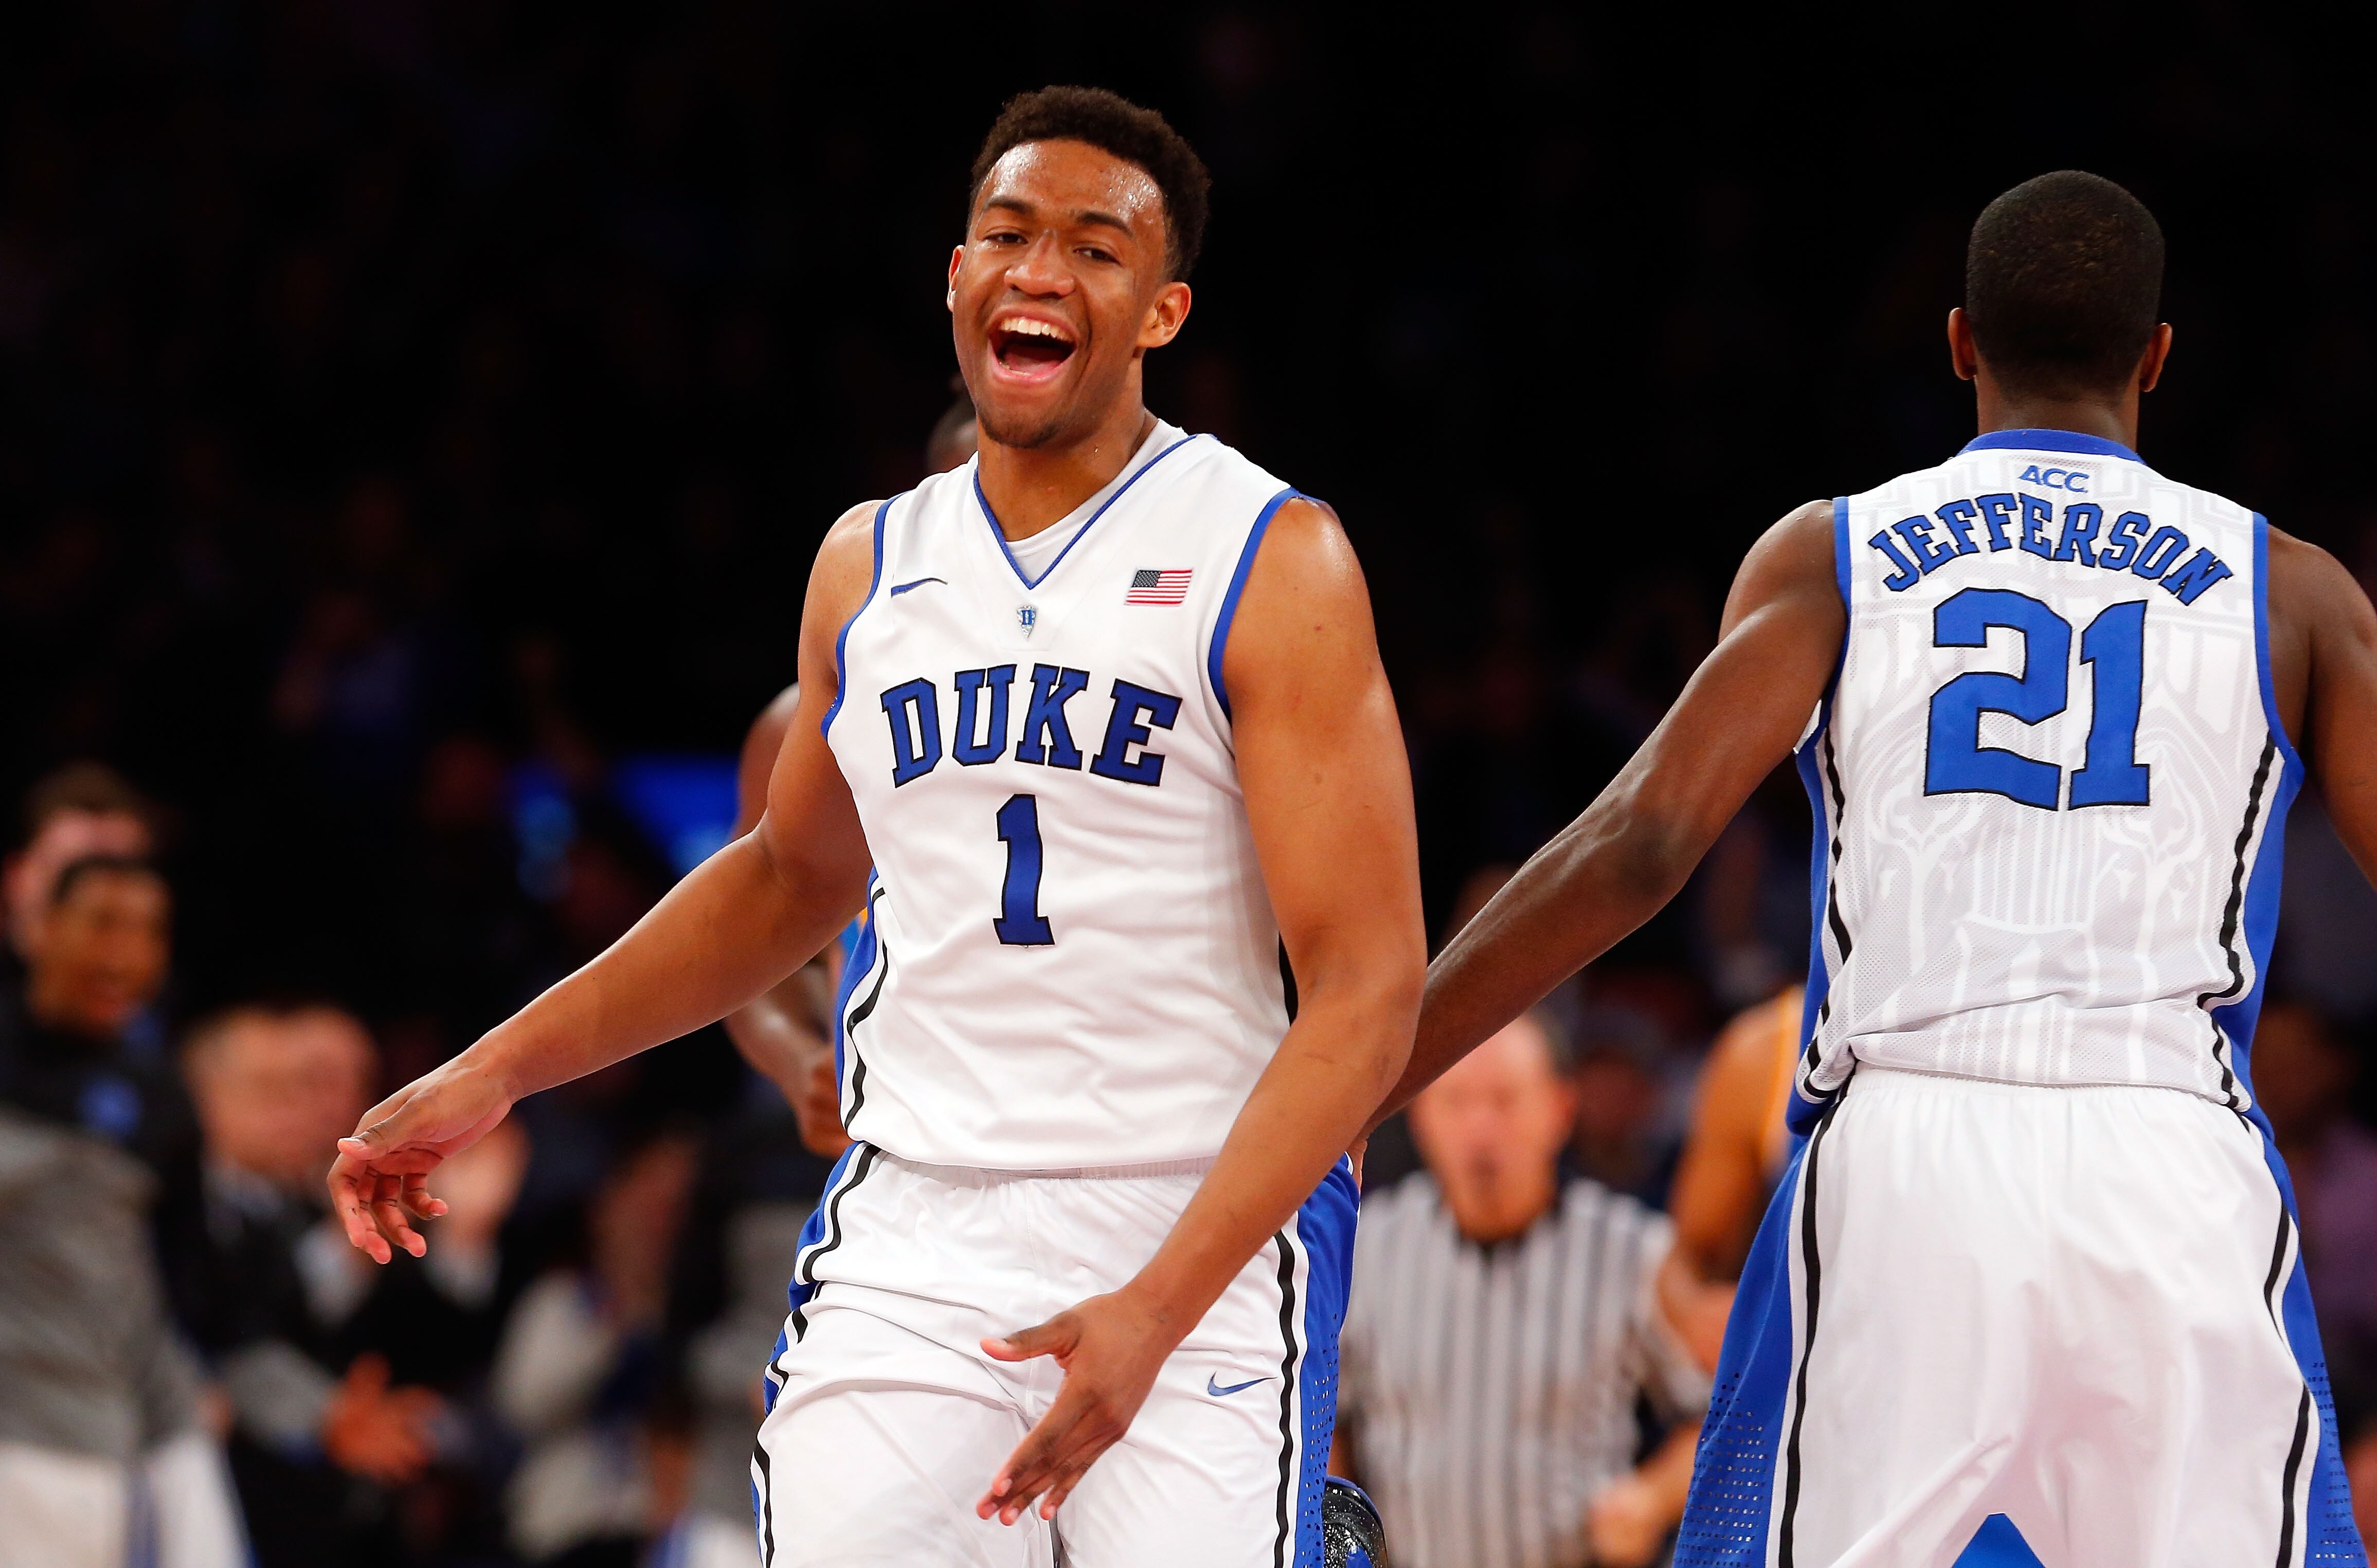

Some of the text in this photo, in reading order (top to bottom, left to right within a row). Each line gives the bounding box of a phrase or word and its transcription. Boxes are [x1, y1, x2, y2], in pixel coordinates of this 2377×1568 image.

[2018, 465, 2090, 493] ACC
[1868, 492, 2234, 606] JEFFERSON
[880, 662, 1183, 788] DUKE
[1923, 587, 2150, 811] 21
[993, 793, 1055, 945] 1
